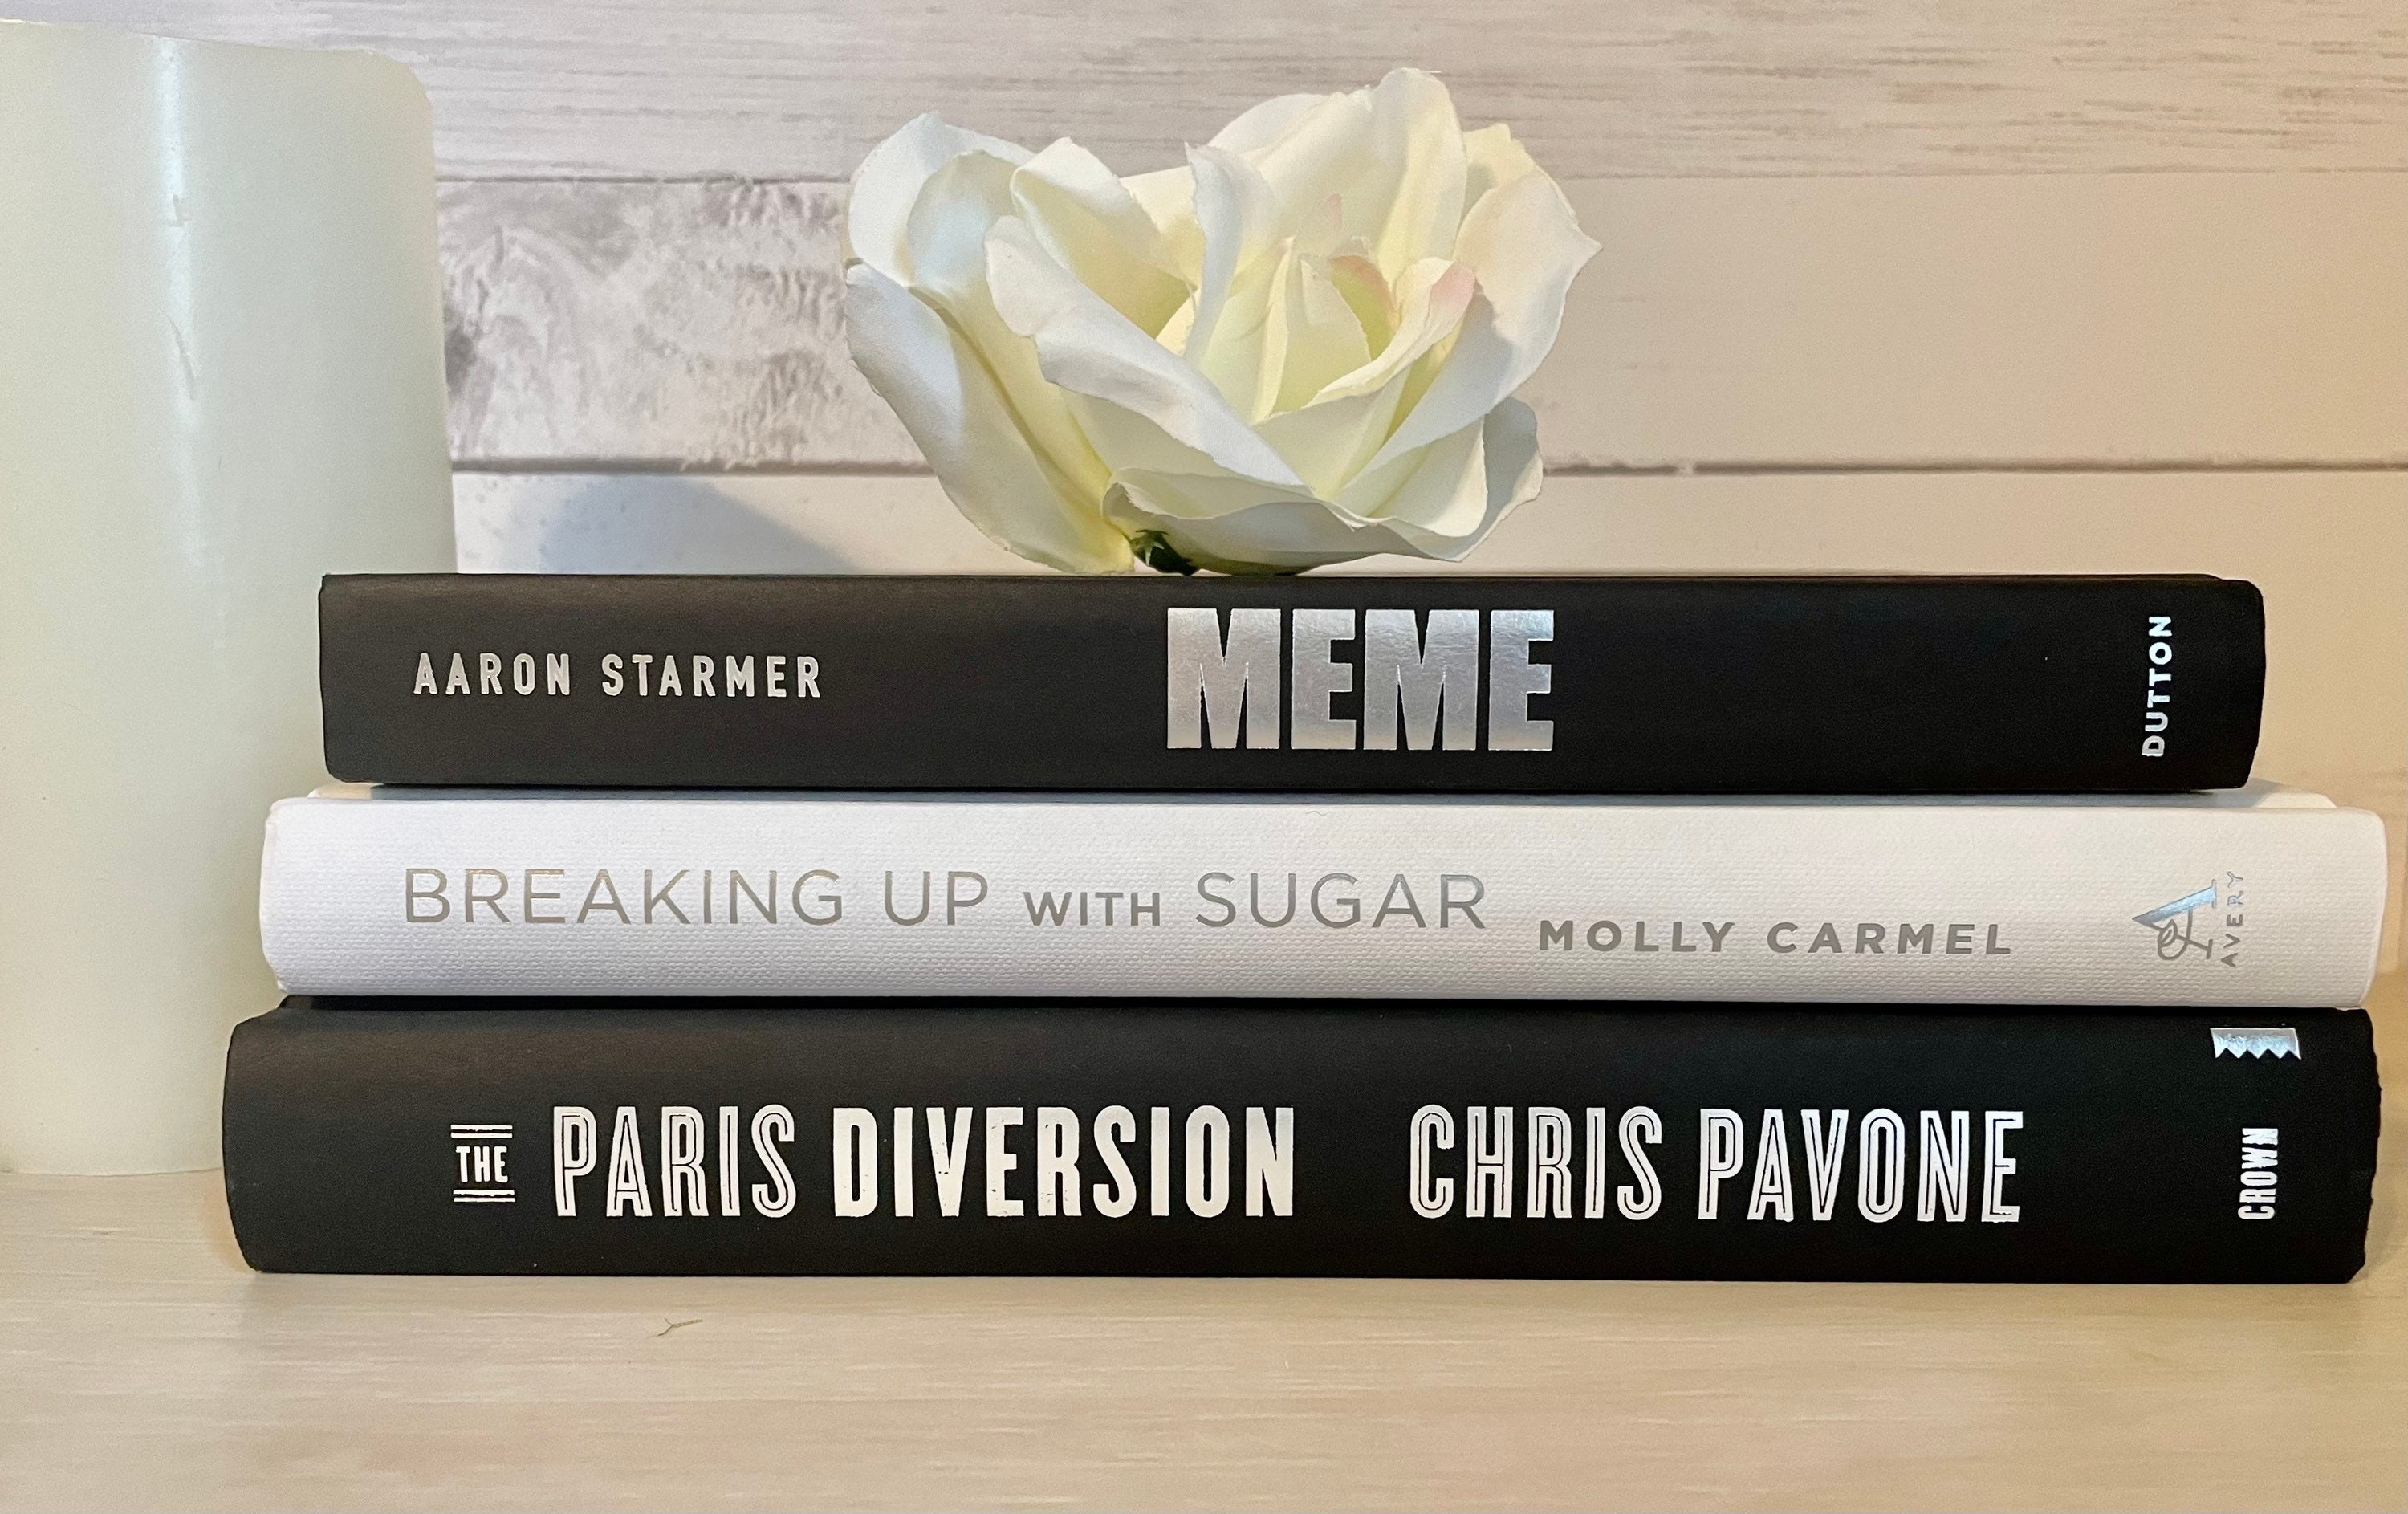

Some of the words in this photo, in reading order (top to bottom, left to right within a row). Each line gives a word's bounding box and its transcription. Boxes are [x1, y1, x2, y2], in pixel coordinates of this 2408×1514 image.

[413, 653, 570, 695] AARON
[601, 653, 820, 698] STARMER
[1166, 607, 1554, 751] MEME
[2142, 616, 2173, 758] DUTTON
[405, 868, 843, 926] BREAKING
[884, 870, 988, 927] UP
[1023, 891, 1161, 927] WITH
[1194, 872, 1487, 930] SUGAR
[1539, 919, 1735, 953] MOLLY
[1767, 922, 2011, 955] CARMEL
[2220, 871, 2244, 967] AVERY
[455, 1146, 509, 1183] THE
[553, 1104, 796, 1218] PARIS
[832, 1105, 1294, 1219] DIVERSION
[1409, 1104, 1662, 1221] CHRIS
[1698, 1108, 2024, 1223] PAVONE
[2237, 1127, 2279, 1220] CROWN
